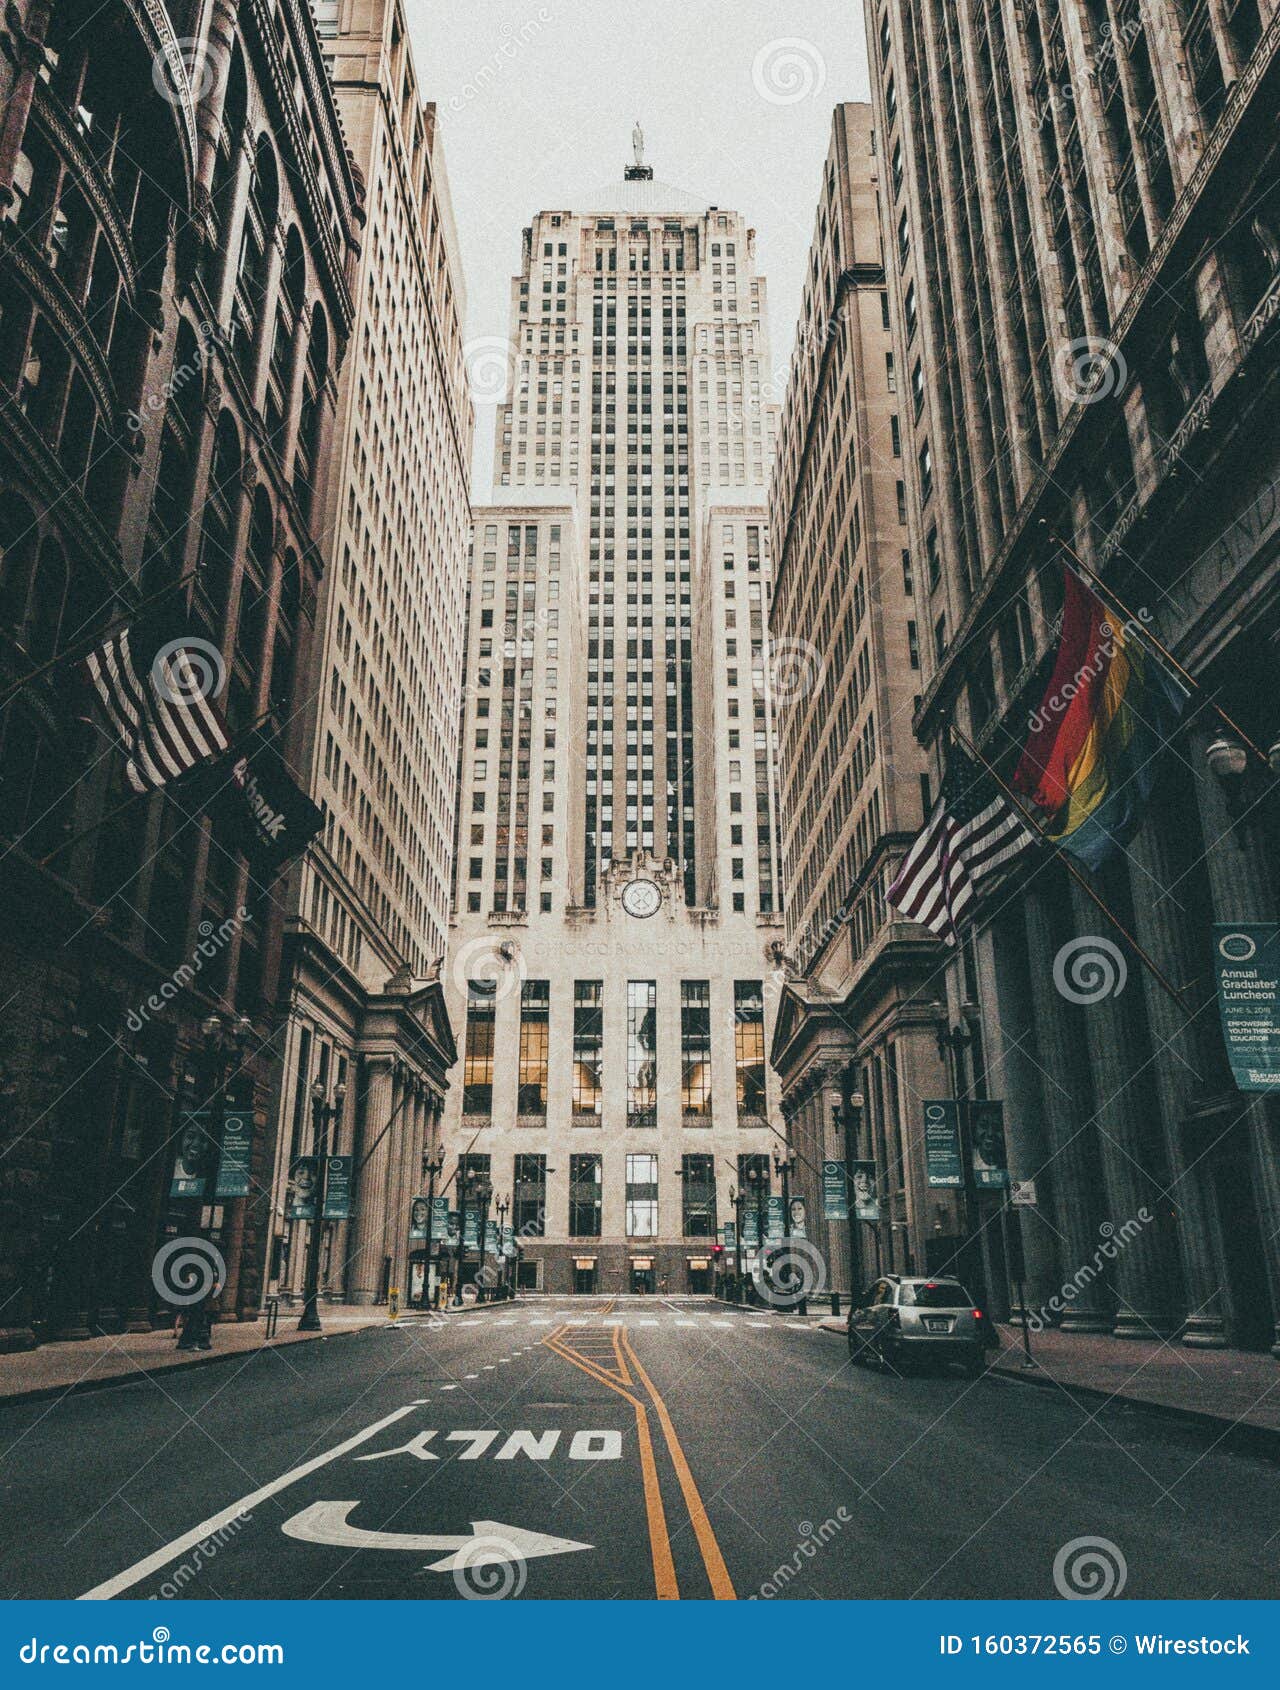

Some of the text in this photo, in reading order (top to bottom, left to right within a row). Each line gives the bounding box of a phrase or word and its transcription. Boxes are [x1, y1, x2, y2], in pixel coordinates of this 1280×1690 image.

[1221, 969, 1258, 978] Annual
[1222, 979, 1278, 989] Graduates'
[1223, 990, 1276, 999] Luncheon
[354, 1430, 622, 1460] ONLY
